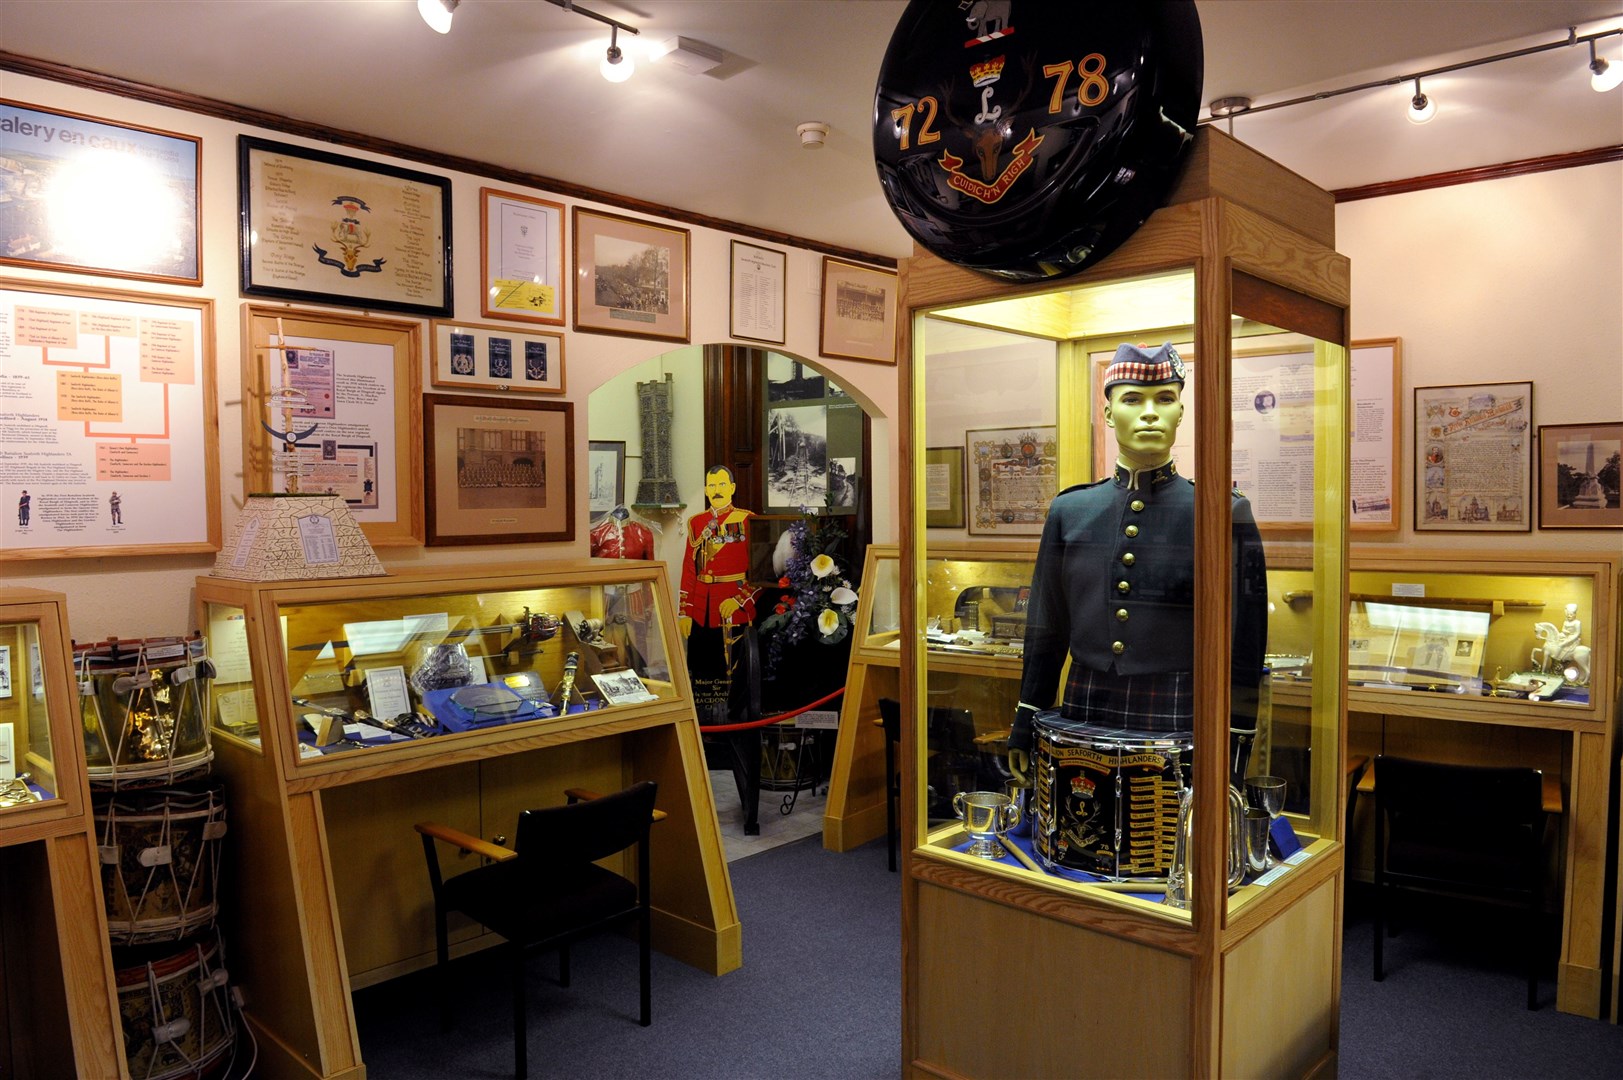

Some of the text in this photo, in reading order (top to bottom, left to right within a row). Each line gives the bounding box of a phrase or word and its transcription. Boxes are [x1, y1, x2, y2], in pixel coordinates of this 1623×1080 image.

[1043, 53, 1109, 114] 78
[59, 128, 85, 146] en
[88, 134, 137, 154] caux
[891, 95, 941, 151] 72
[952, 158, 1026, 199] CUIDICH'N RIGH
[1067, 749, 1103, 762] SEAFORTH
[1108, 755, 1162, 765] HIGHLANDERS
